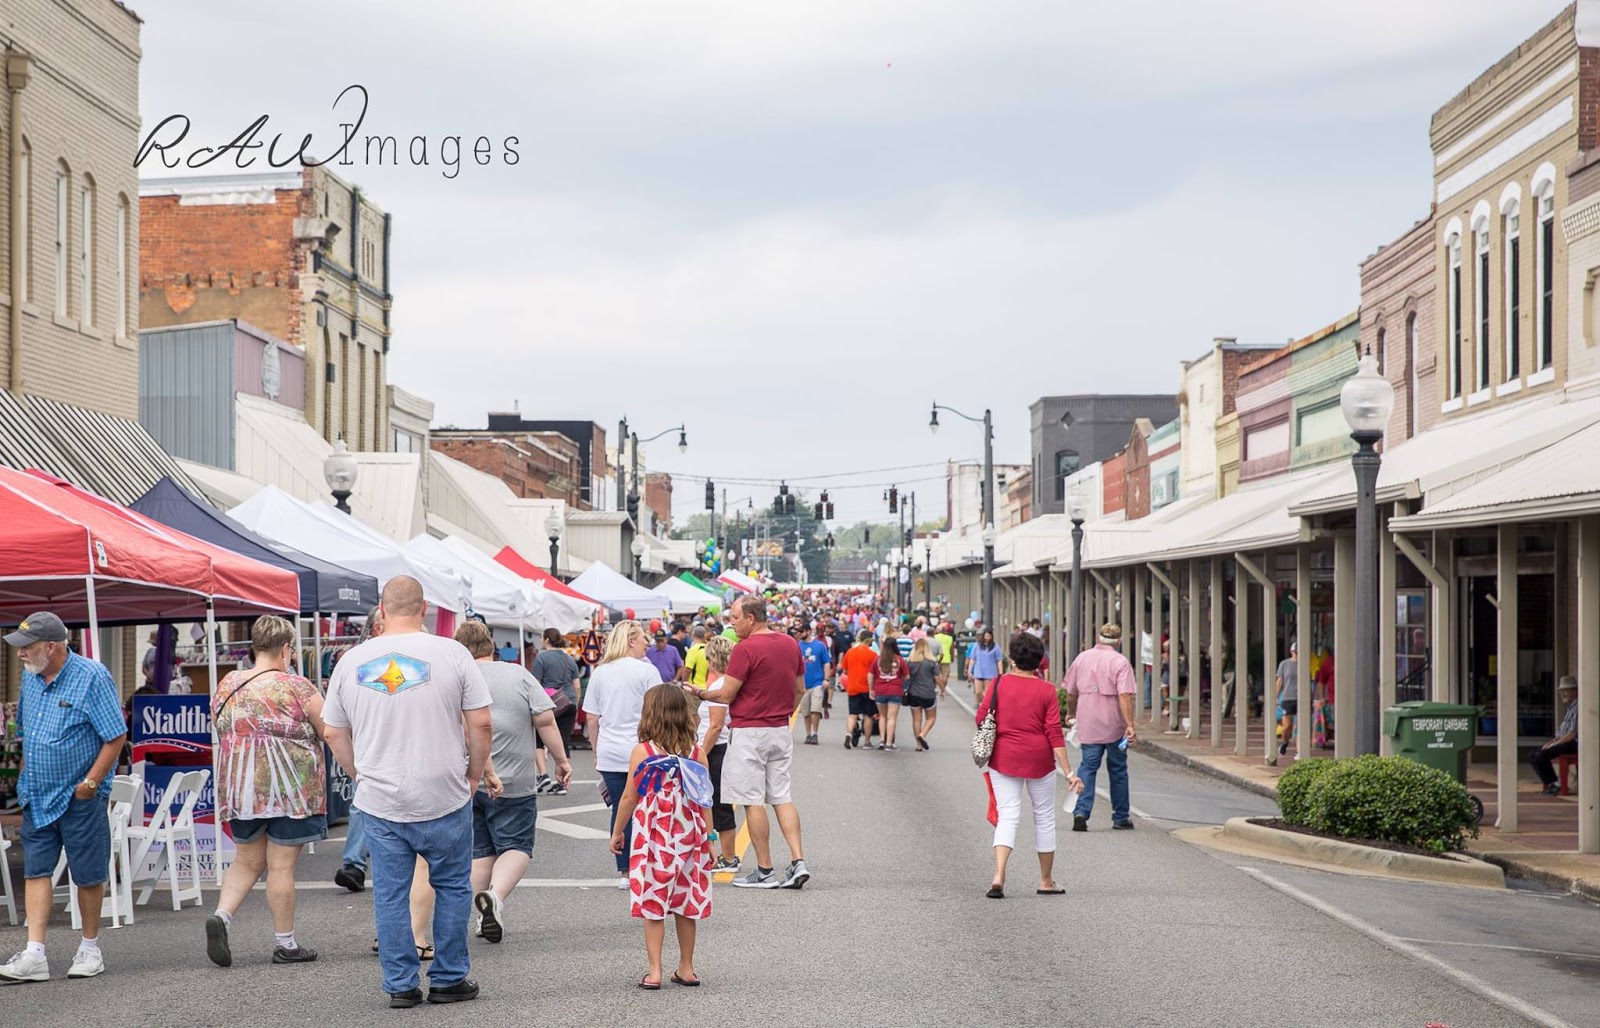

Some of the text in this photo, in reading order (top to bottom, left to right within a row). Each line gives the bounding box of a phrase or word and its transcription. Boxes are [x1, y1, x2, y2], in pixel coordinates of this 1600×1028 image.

[1412, 718, 1469, 731] TEMPORARY GARBAGE
[180, 854, 214, 863] STTE
